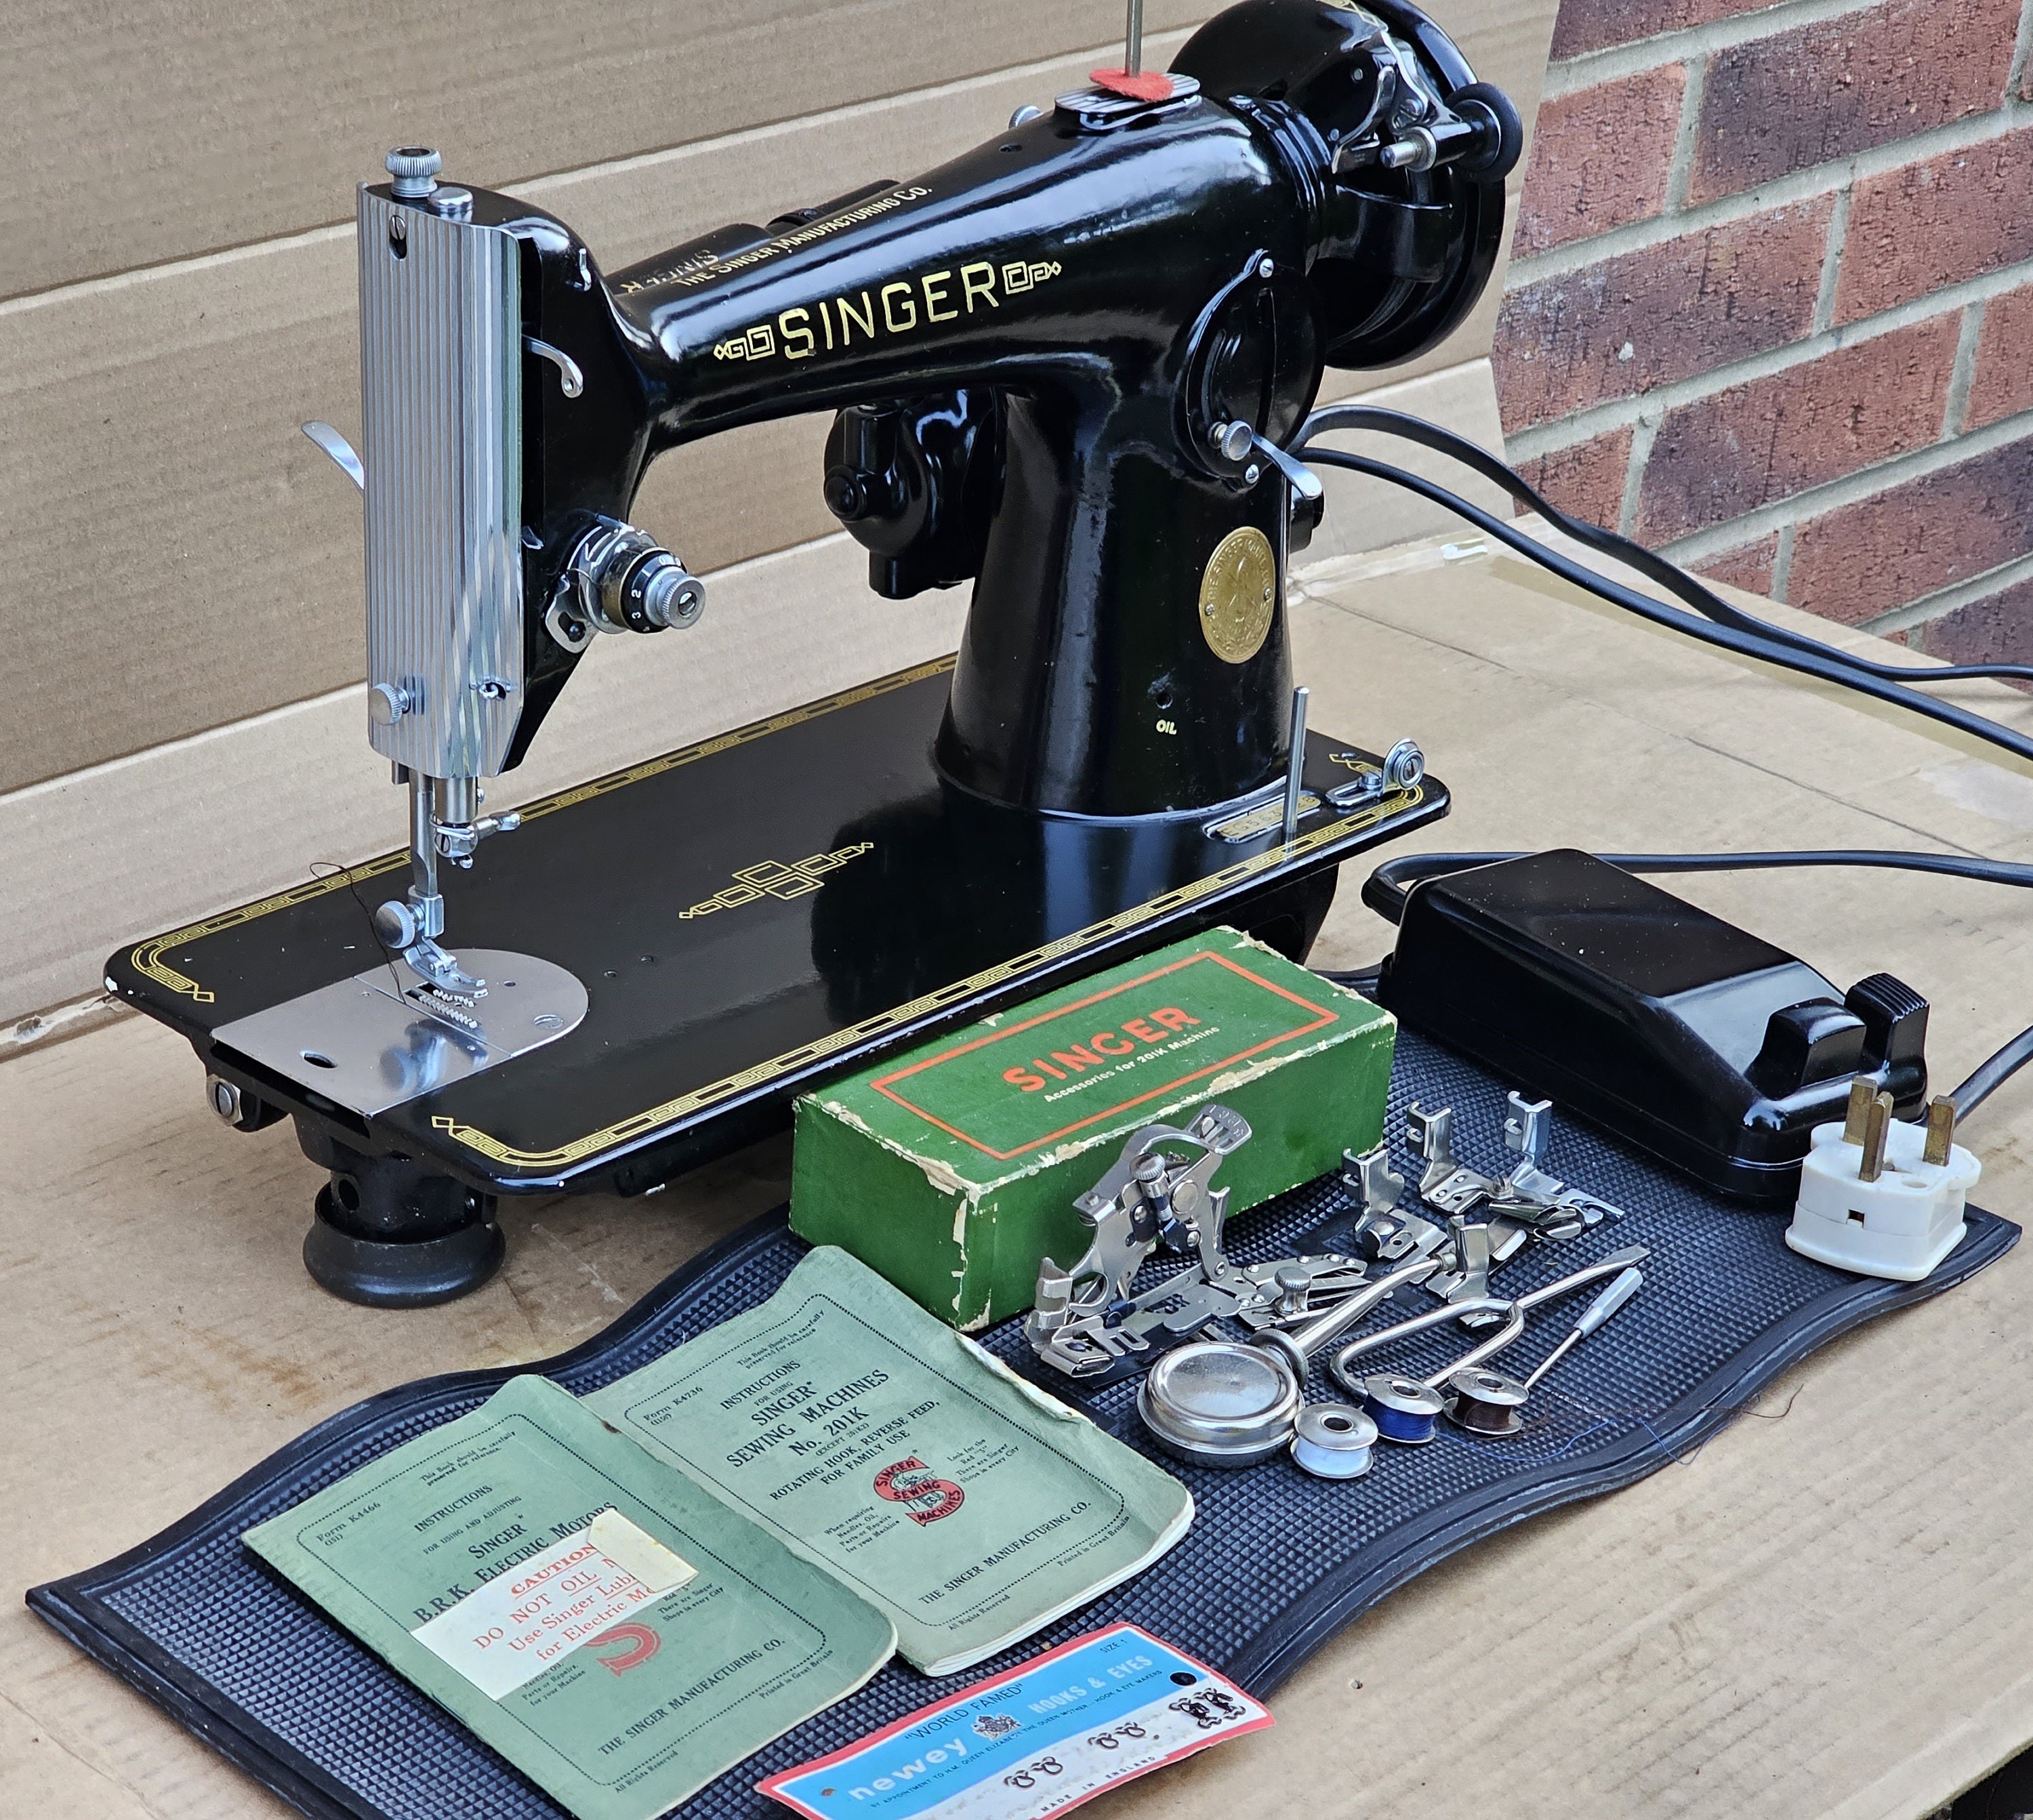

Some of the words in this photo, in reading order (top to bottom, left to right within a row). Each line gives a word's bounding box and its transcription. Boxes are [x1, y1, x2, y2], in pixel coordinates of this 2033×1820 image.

[670, 272, 716, 287] THE
[709, 247, 780, 274] SINGER
[779, 197, 901, 250] MANUFACTURING
[779, 261, 1000, 360] SINGER
[631, 589, 642, 599] 2
[631, 611, 642, 619] 3
[1156, 719, 1177, 736] OIL
[1002, 1006, 1202, 1092] SINGER
[1044, 1069, 1115, 1102] Accessories
[1115, 1059, 1136, 1073] for
[1136, 1047, 1168, 1064] 201K
[1168, 1026, 1220, 1050] Machine
[737, 1355, 752, 1366] This
[752, 1346, 768, 1358] Book
[768, 1335, 789, 1350] should
[798, 1309, 825, 1334] carefully
[745, 1350, 776, 1369] preserved
[775, 1344, 787, 1354] for
[644, 1404, 672, 1421] Form
[672, 1386, 703, 1406] K4736
[720, 1360, 801, 1410] INSTRUCTIONS
[754, 1395, 771, 1407] FOR
[770, 1381, 794, 1398] USING
[726, 1423, 796, 1468] SEWING
[798, 1369, 889, 1424] MACHINES
[788, 1440, 822, 1456] No.
[823, 1406, 869, 1436] 201K
[419, 1470, 436, 1483] This
[436, 1460, 455, 1473] Book
[455, 1449, 477, 1464] should
[488, 1430, 516, 1451] carefully
[769, 1466, 825, 1500] ROTATING
[824, 1445, 862, 1468] HOOK,
[860, 1415, 909, 1446] REVERSE
[907, 1400, 941, 1420] FEED,
[815, 1436, 846, 1456] (EXCEPT
[820, 1469, 846, 1485] FOR
[844, 1444, 886, 1471] FAMILY
[886, 1429, 910, 1445] USE
[947, 1451, 965, 1462] Look
[975, 1438, 986, 1447] the
[956, 1464, 977, 1477] There
[977, 1458, 988, 1467] are
[987, 1443, 1009, 1460] Singer
[960, 1455, 974, 1466] Red
[960, 1472, 981, 1484] Shops
[987, 1457, 1007, 1470] every
[1006, 1444, 1020, 1457] City
[426, 1468, 457, 1487] preserved
[457, 1460, 470, 1470] for
[876, 1460, 916, 1488] SINGER
[893, 1481, 941, 1501] SEWING
[316, 1522, 347, 1543] Form
[348, 1501, 381, 1524] K4466
[413, 1484, 493, 1533] INSTRUCTIONS
[423, 1543, 440, 1556] FOR
[439, 1528, 464, 1545] USING
[465, 1518, 482, 1531] AND
[482, 1495, 523, 1519] ADJUSTING
[824, 1523, 845, 1535] When
[844, 1505, 876, 1525] requiring
[916, 1489, 961, 1523] MACHINES
[839, 1535, 859, 1547] Parts
[867, 1514, 892, 1533] Repairs
[845, 1544, 858, 1553] for
[857, 1535, 874, 1548] your
[872, 1519, 901, 1539] Machine
[918, 1589, 945, 1605] THE
[944, 1565, 984, 1592] SINGER
[982, 1513, 1071, 1567] MANUFACTURING
[1071, 1500, 1092, 1515] CO.
[1058, 1550, 1083, 1567] Printed
[1089, 1534, 1109, 1549] Great
[1108, 1515, 1130, 1538] Britain
[413, 1583, 475, 1623] B.R.K.
[474, 1537, 550, 1584] ELECTRIC
[511, 1544, 598, 1595] CAUTION
[472, 1626, 504, 1649] DO
[510, 1592, 553, 1624] NOT
[560, 1570, 598, 1593] OIL
[657, 1602, 679, 1614] There
[691, 1582, 714, 1597] Singer
[663, 1610, 684, 1621] Shops
[691, 1596, 710, 1607] every
[708, 1587, 724, 1598] City
[948, 1621, 959, 1632] All
[958, 1611, 981, 1628] Rights
[979, 1594, 1011, 1615] Reserved
[508, 1628, 543, 1651] Use
[542, 1594, 596, 1629] Singer
[536, 1640, 562, 1661] for
[561, 1602, 628, 1642] Electric
[1100, 1641, 1120, 1653] SIZE
[521, 1687, 542, 1701] Parts
[529, 1698, 542, 1706] for
[541, 1688, 558, 1700] your
[557, 1670, 586, 1689] Machine
[598, 1738, 626, 1756] THE
[625, 1708, 669, 1739] SINGER
[668, 1649, 763, 1710] MANUFACTURING
[763, 1637, 786, 1651] CO.
[759, 1680, 785, 1699] Printed
[792, 1663, 812, 1680] Great
[811, 1648, 834, 1668] Britain
[1028, 1684, 1088, 1714] HOOKS
[1087, 1676, 1107, 1689] &
[1106, 1654, 1153, 1680] EYES
[870, 1800, 881, 1808] BY
[882, 1777, 932, 1804] APPOINTMENT
[933, 1772, 945, 1780] TO
[945, 1764, 961, 1775] H.M.
[961, 1750, 985, 1766] QUEEN
[1023, 1722, 1038, 1732] THE
[1037, 1714, 1061, 1726] QUEEN
[1060, 1703, 1088, 1717] MOTHER
[1121, 1682, 1135, 1691] EYE
[1136, 1669, 1164, 1684] MAKERS
[614, 1781, 627, 1794] All
[626, 1766, 650, 1787] Rights
[649, 1749, 678, 1772] Reserved
[848, 1737, 967, 1800] newey
[1040, 1793, 1073, 1813] MADE
[1082, 1781, 1096, 1791] IN
[1104, 1756, 1157, 1779] ENGLAND
